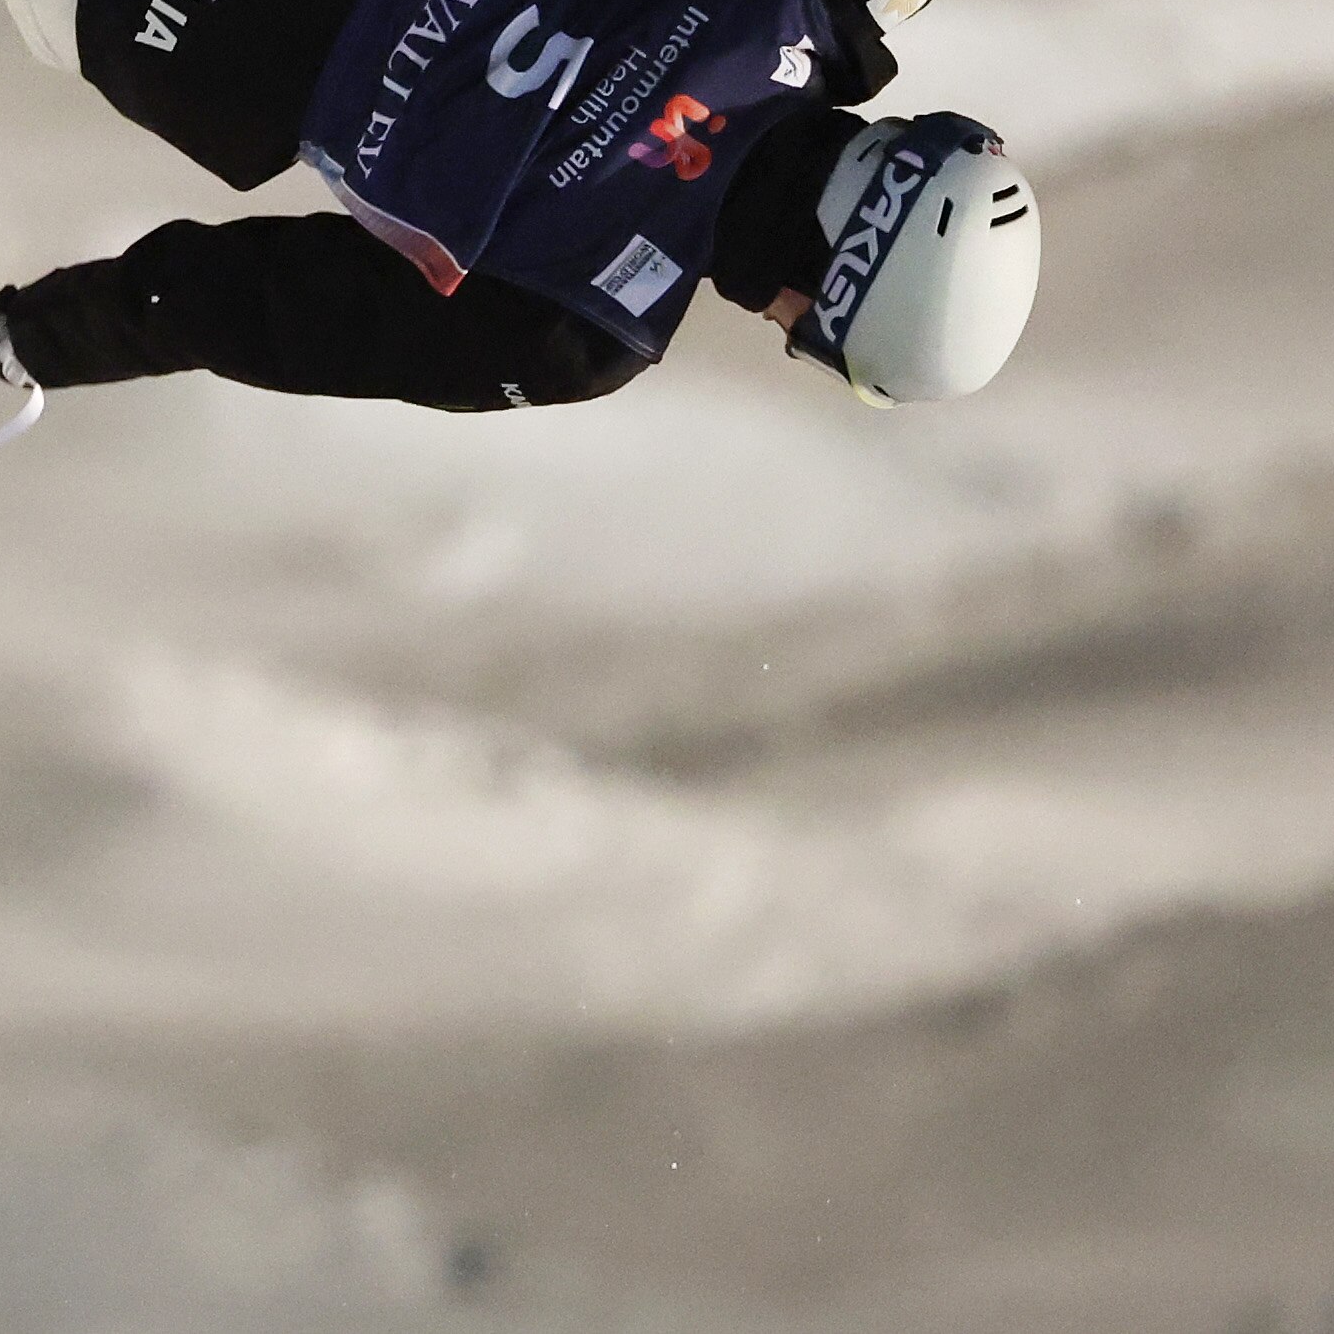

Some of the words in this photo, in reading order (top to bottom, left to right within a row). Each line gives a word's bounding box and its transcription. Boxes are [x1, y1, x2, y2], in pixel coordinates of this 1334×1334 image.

[486, 4, 595, 111] 5
[549, 6, 709, 189] Intermountain
[570, 47, 648, 124] Health
[815, 149, 925, 343] OAKLEY
